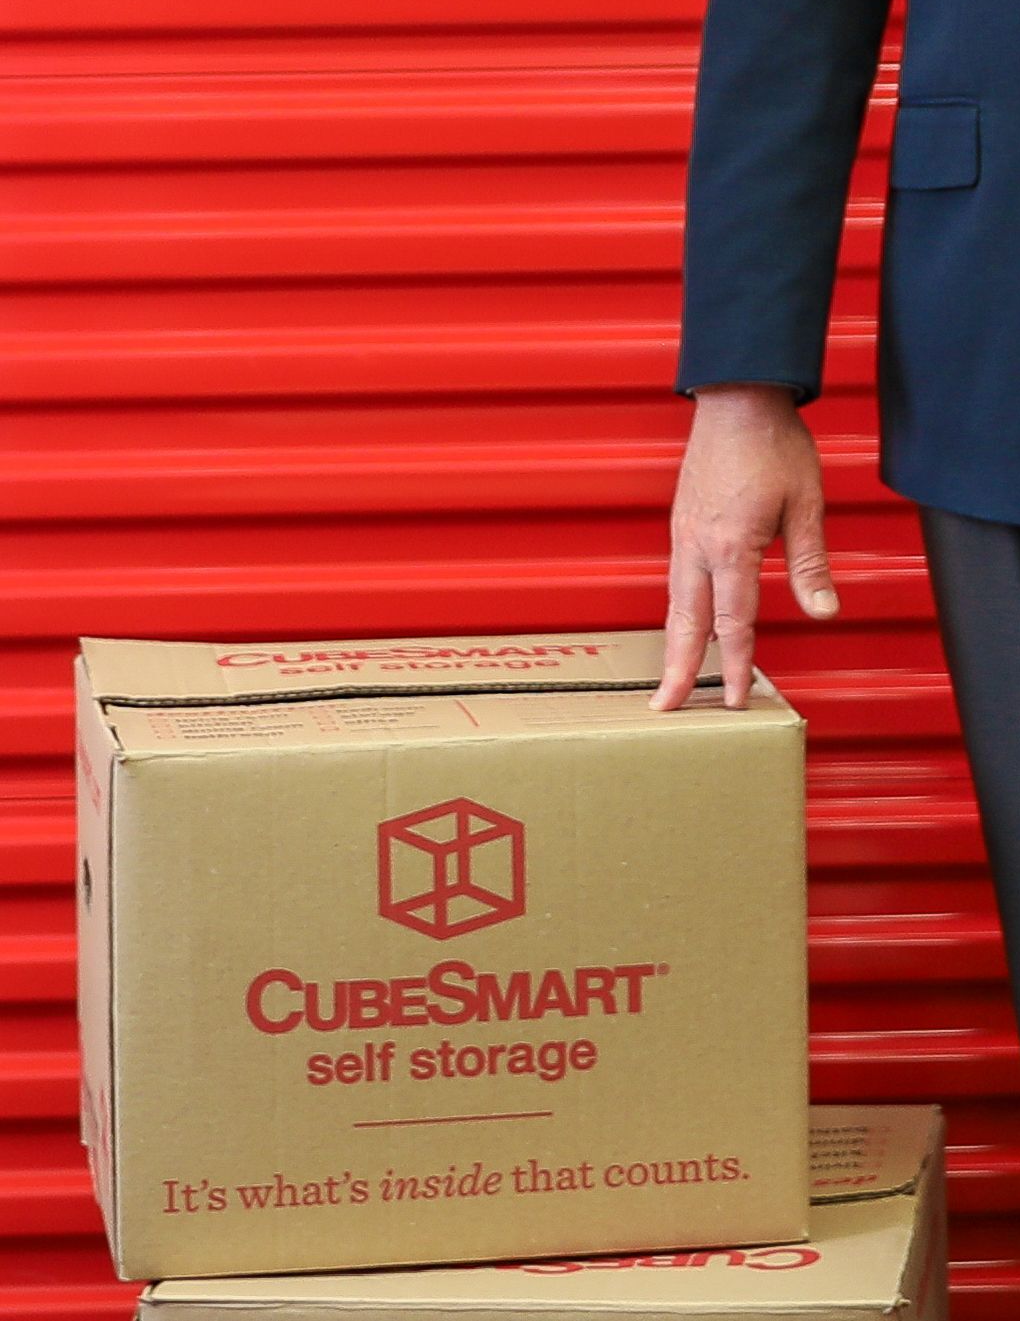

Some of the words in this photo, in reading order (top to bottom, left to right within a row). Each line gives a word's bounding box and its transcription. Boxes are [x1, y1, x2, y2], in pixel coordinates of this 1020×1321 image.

[280, 658, 361, 674] self
[380, 657, 560, 669] storage
[307, 1043, 396, 1085] self
[410, 1038, 597, 1082] storage
[162, 1178, 227, 1214] It's
[236, 1171, 369, 1210] what's
[381, 1162, 502, 1202] inside
[511, 1158, 595, 1193] that
[603, 1151, 750, 1188] counts.
